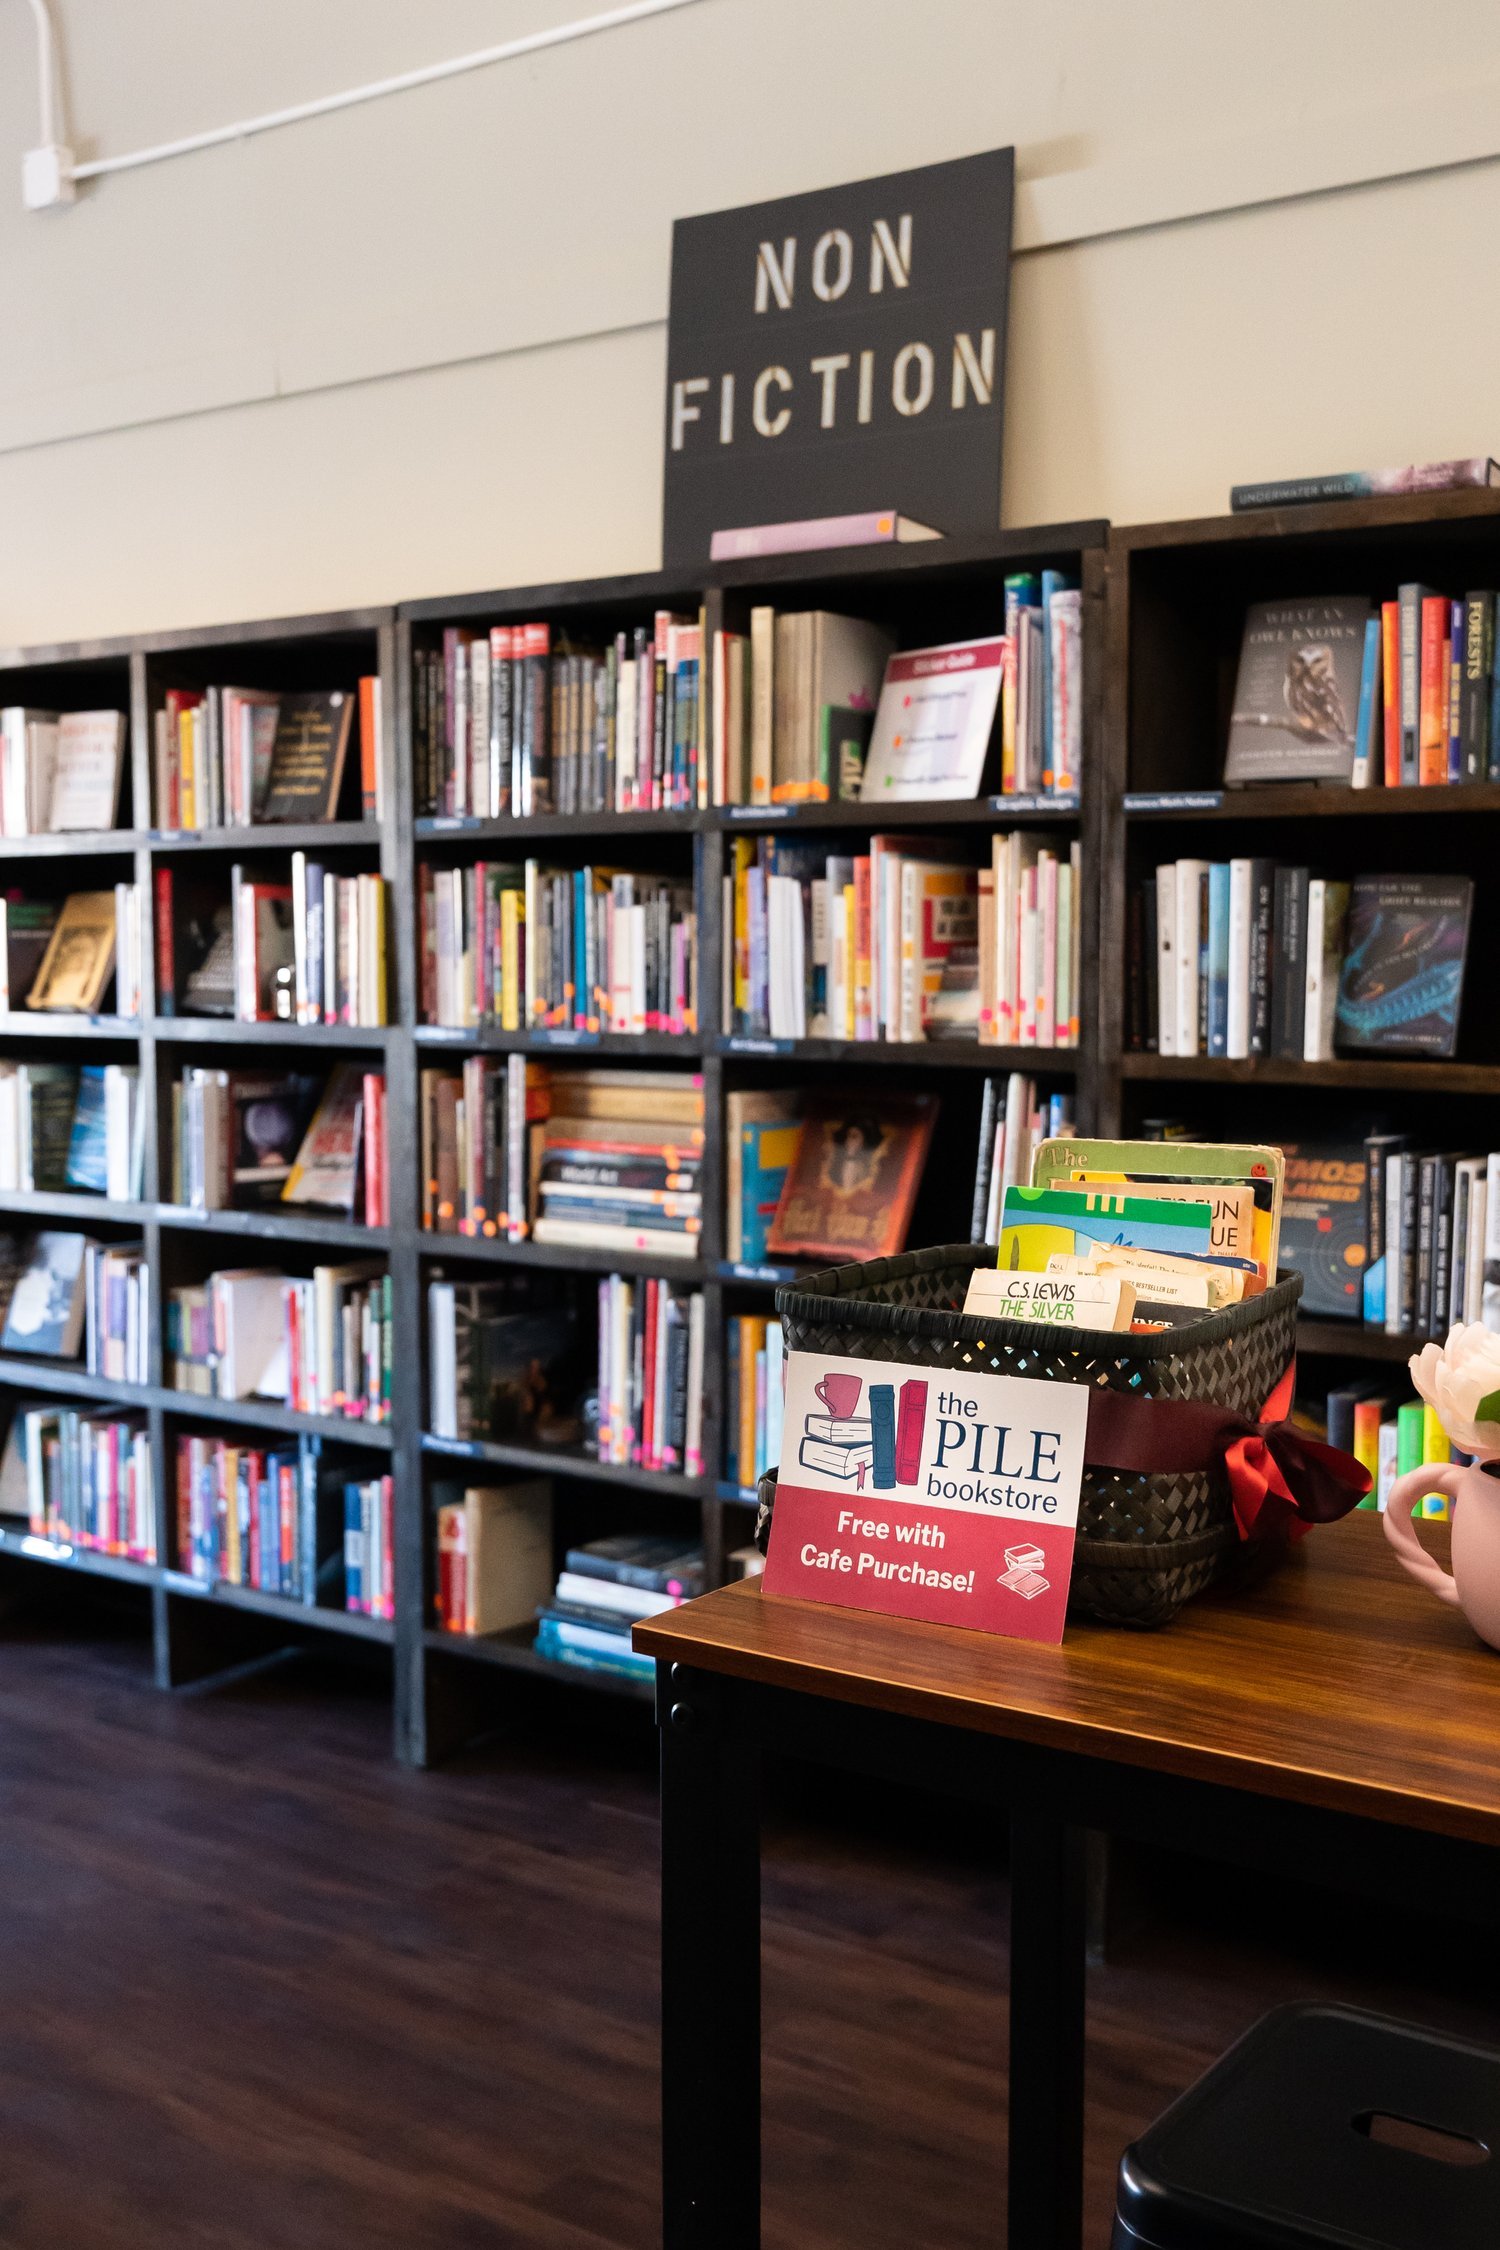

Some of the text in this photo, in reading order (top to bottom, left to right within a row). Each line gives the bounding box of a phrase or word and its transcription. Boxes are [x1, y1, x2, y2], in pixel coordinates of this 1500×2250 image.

[754, 213, 913, 314] NON
[672, 329, 995, 450] FICTION
[1467, 601, 1483, 679] FORESTS
[1047, 1147, 1088, 1167] The
[1196, 1199, 1240, 1220] UN
[1210, 1227, 1238, 1247] UE
[1007, 1281, 1076, 1301] C.S. LEWIS
[1136, 1282, 1166, 1293] BESTSELLER
[1166, 1287, 1178, 1295] LIST
[999, 1299, 1075, 1321] THE SILVER
[938, 1391, 978, 1418] the
[931, 1418, 1061, 1484] PILE
[926, 1473, 1058, 1514] bookstore
[837, 1511, 946, 1549] Free with
[800, 1544, 975, 1594] Cafe Purchase!
